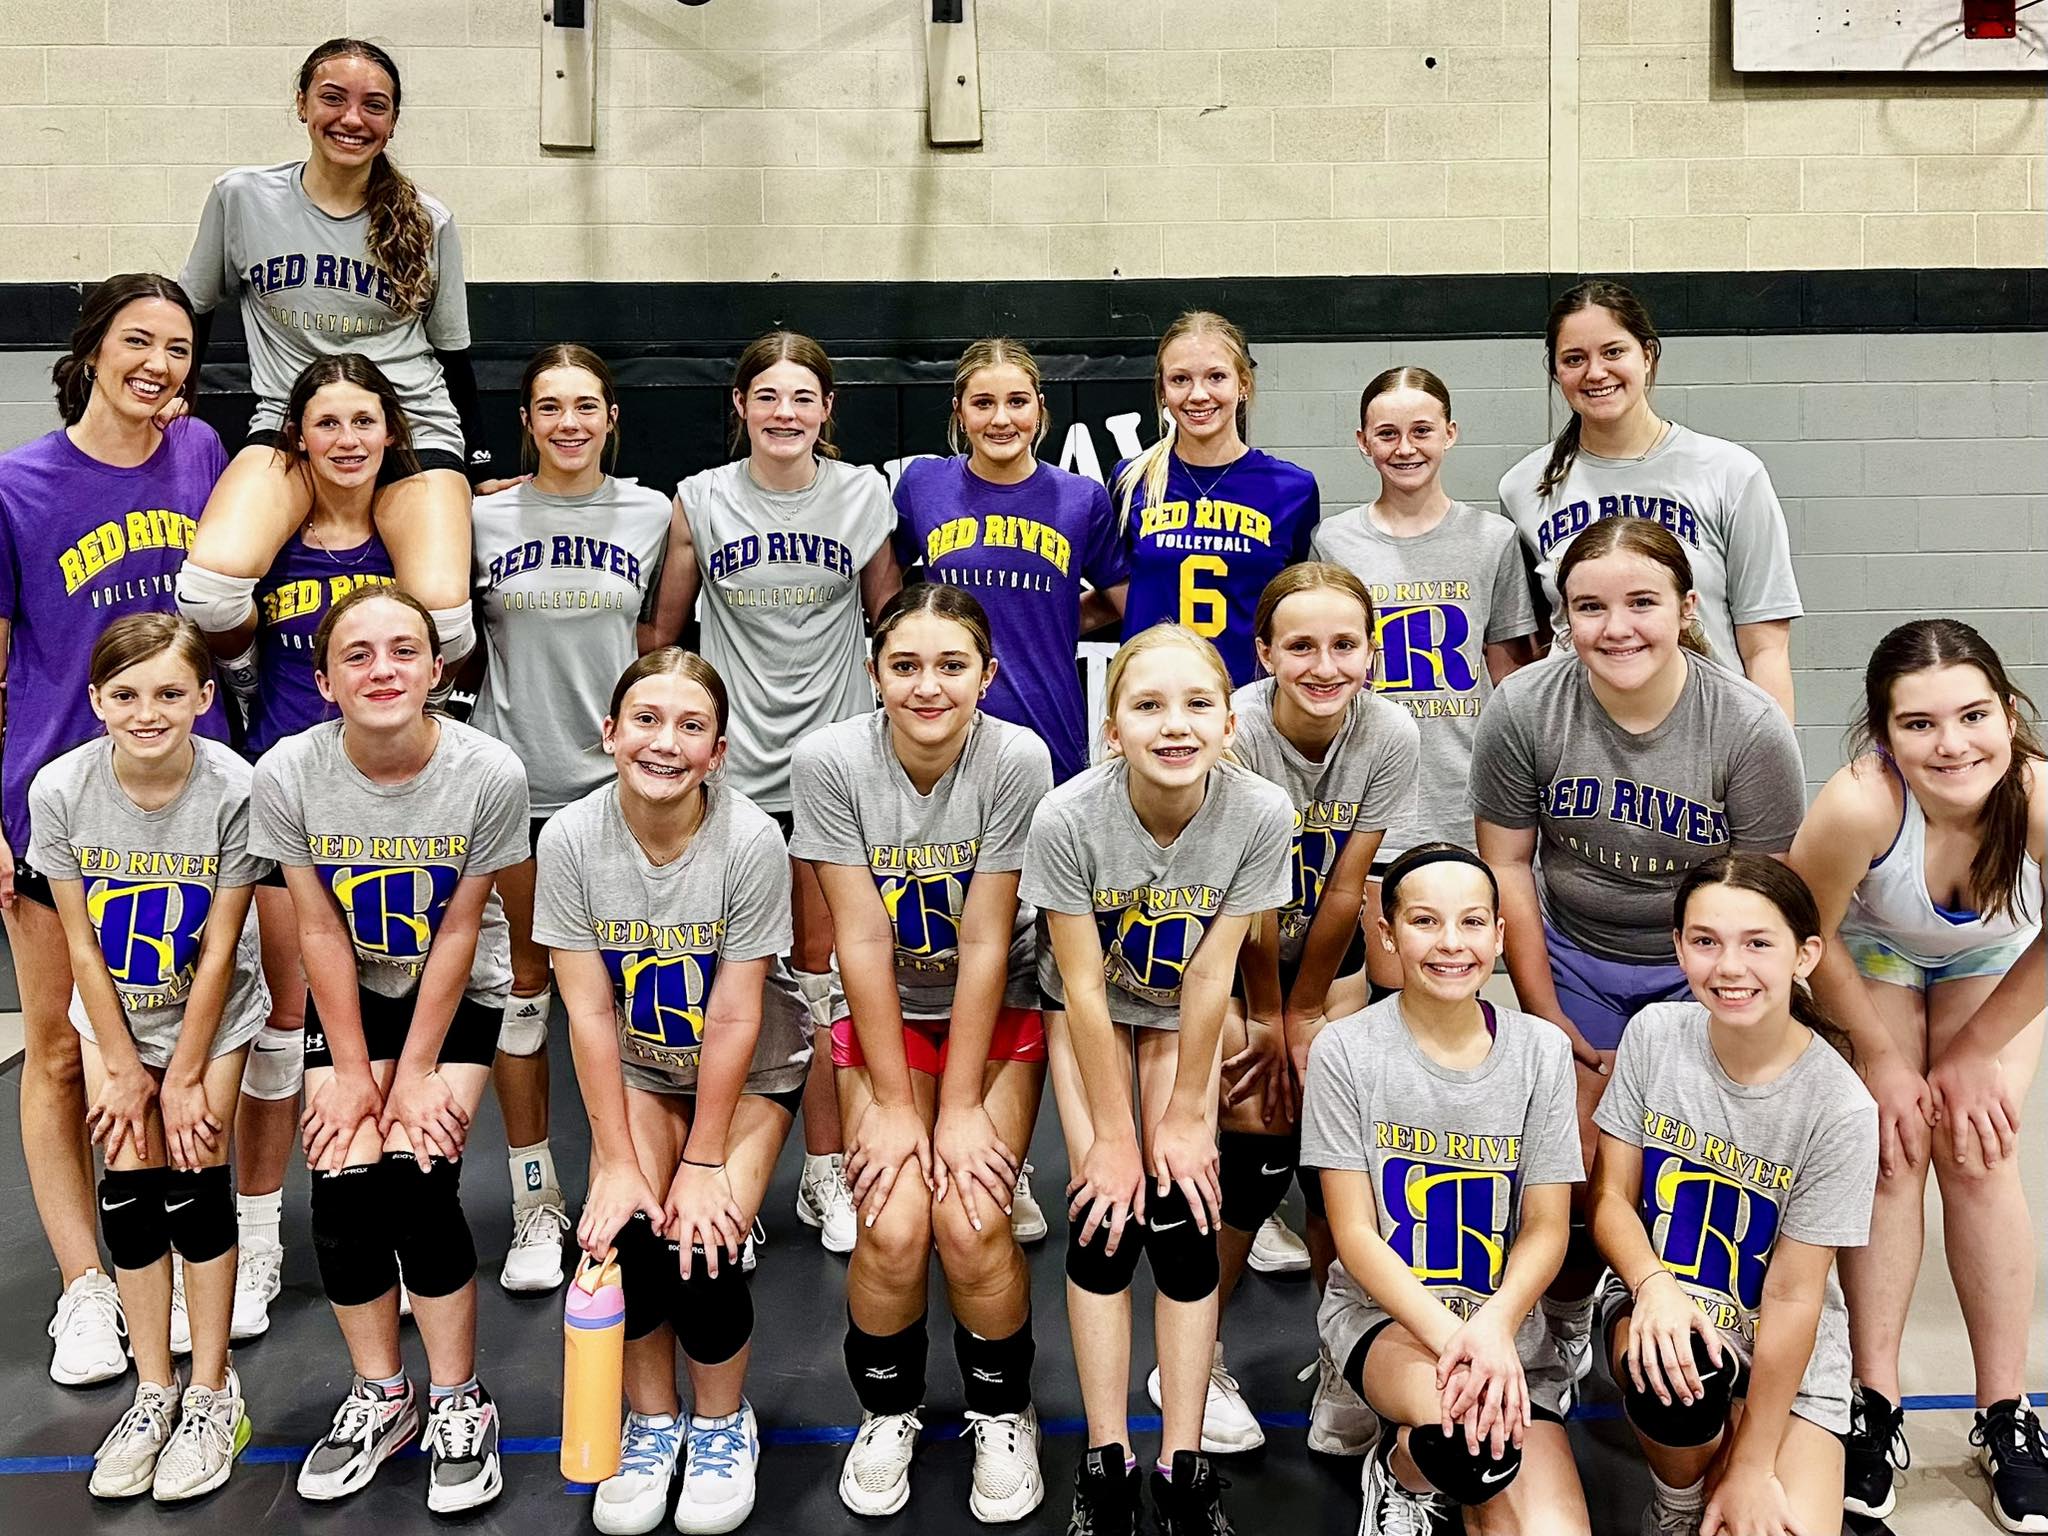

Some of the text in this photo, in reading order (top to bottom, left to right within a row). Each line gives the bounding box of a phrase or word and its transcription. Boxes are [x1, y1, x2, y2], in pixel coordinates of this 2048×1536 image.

[250, 253, 398, 312] RED RIVE
[1139, 499, 1272, 547] RED RIVER
[1156, 533, 1252, 554] VOLLEYBALL
[1537, 494, 1700, 557] RED RIVER
[58, 509, 199, 597] RED RIVE
[488, 535, 641, 595] RED RIVER
[709, 532, 855, 584] RED RIVER
[926, 514, 1072, 578] RED RIVER
[91, 574, 173, 609] VOLLEYB
[503, 591, 623, 611] VOLLEYBALL
[940, 568, 1052, 592] VOLLEYBALL
[1180, 554, 1229, 639] 6
[1395, 580, 1471, 601] RIVER
[126, 850, 219, 877] RIVER
[305, 834, 469, 861] RED RIVER
[1148, 884, 1224, 912] RIVE
[591, 915, 650, 944] RED
[1374, 1121, 1523, 1163] RED RIVE
[1643, 1106, 1794, 1191] RED RIVER
